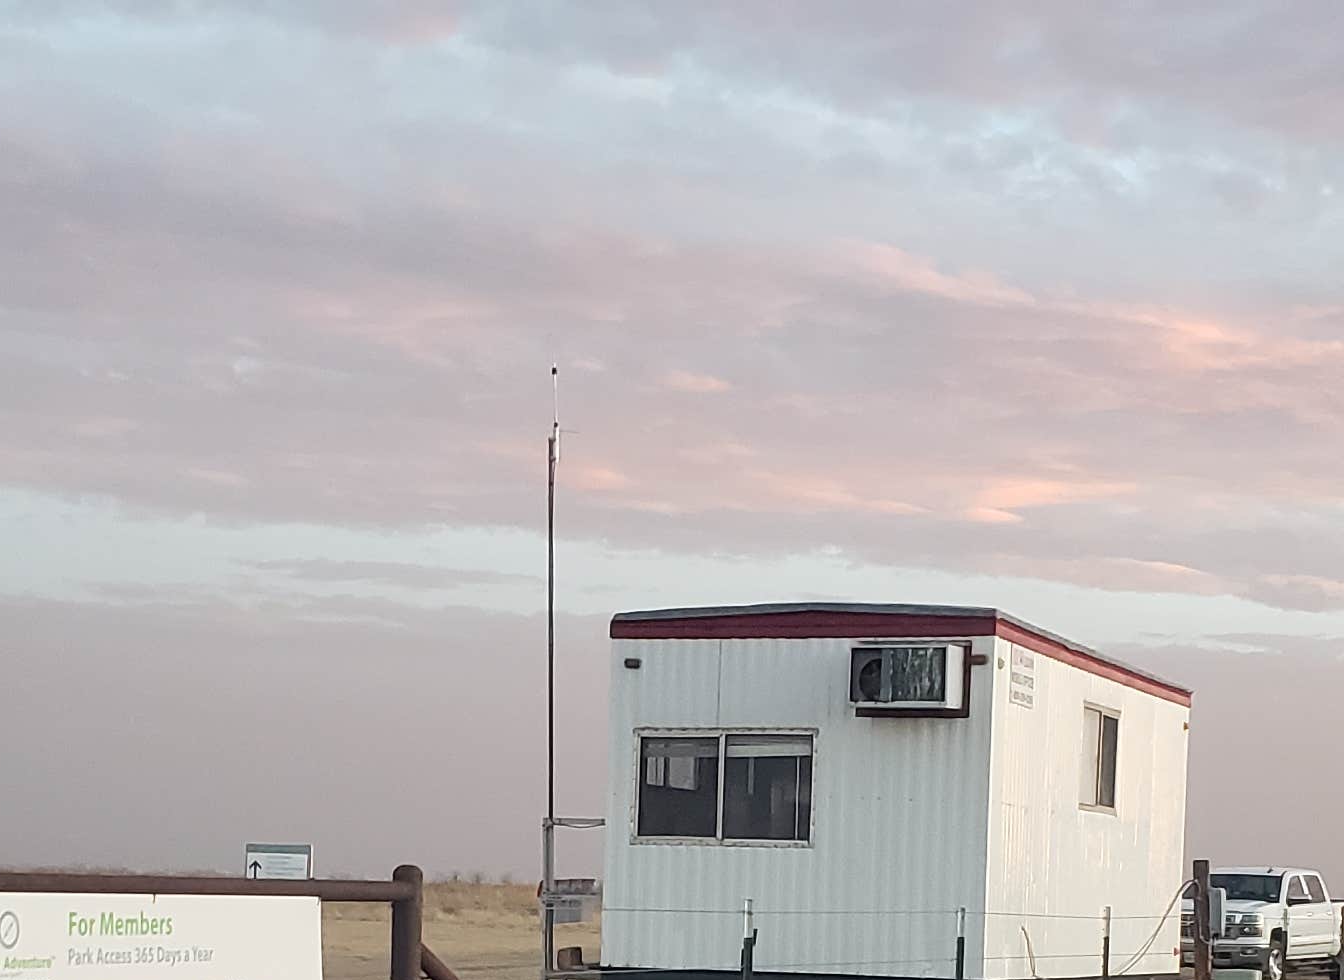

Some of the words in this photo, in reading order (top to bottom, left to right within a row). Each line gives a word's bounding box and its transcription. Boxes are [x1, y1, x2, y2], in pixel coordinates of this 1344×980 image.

[68, 911, 95, 936] For
[99, 910, 173, 936] Members
[68, 947, 93, 966] Park
[96, 947, 132, 965] Access
[134, 947, 154, 964] 365
[157, 946, 182, 967] Days
[184, 950, 190, 963] a
[192, 947, 213, 962] Year
